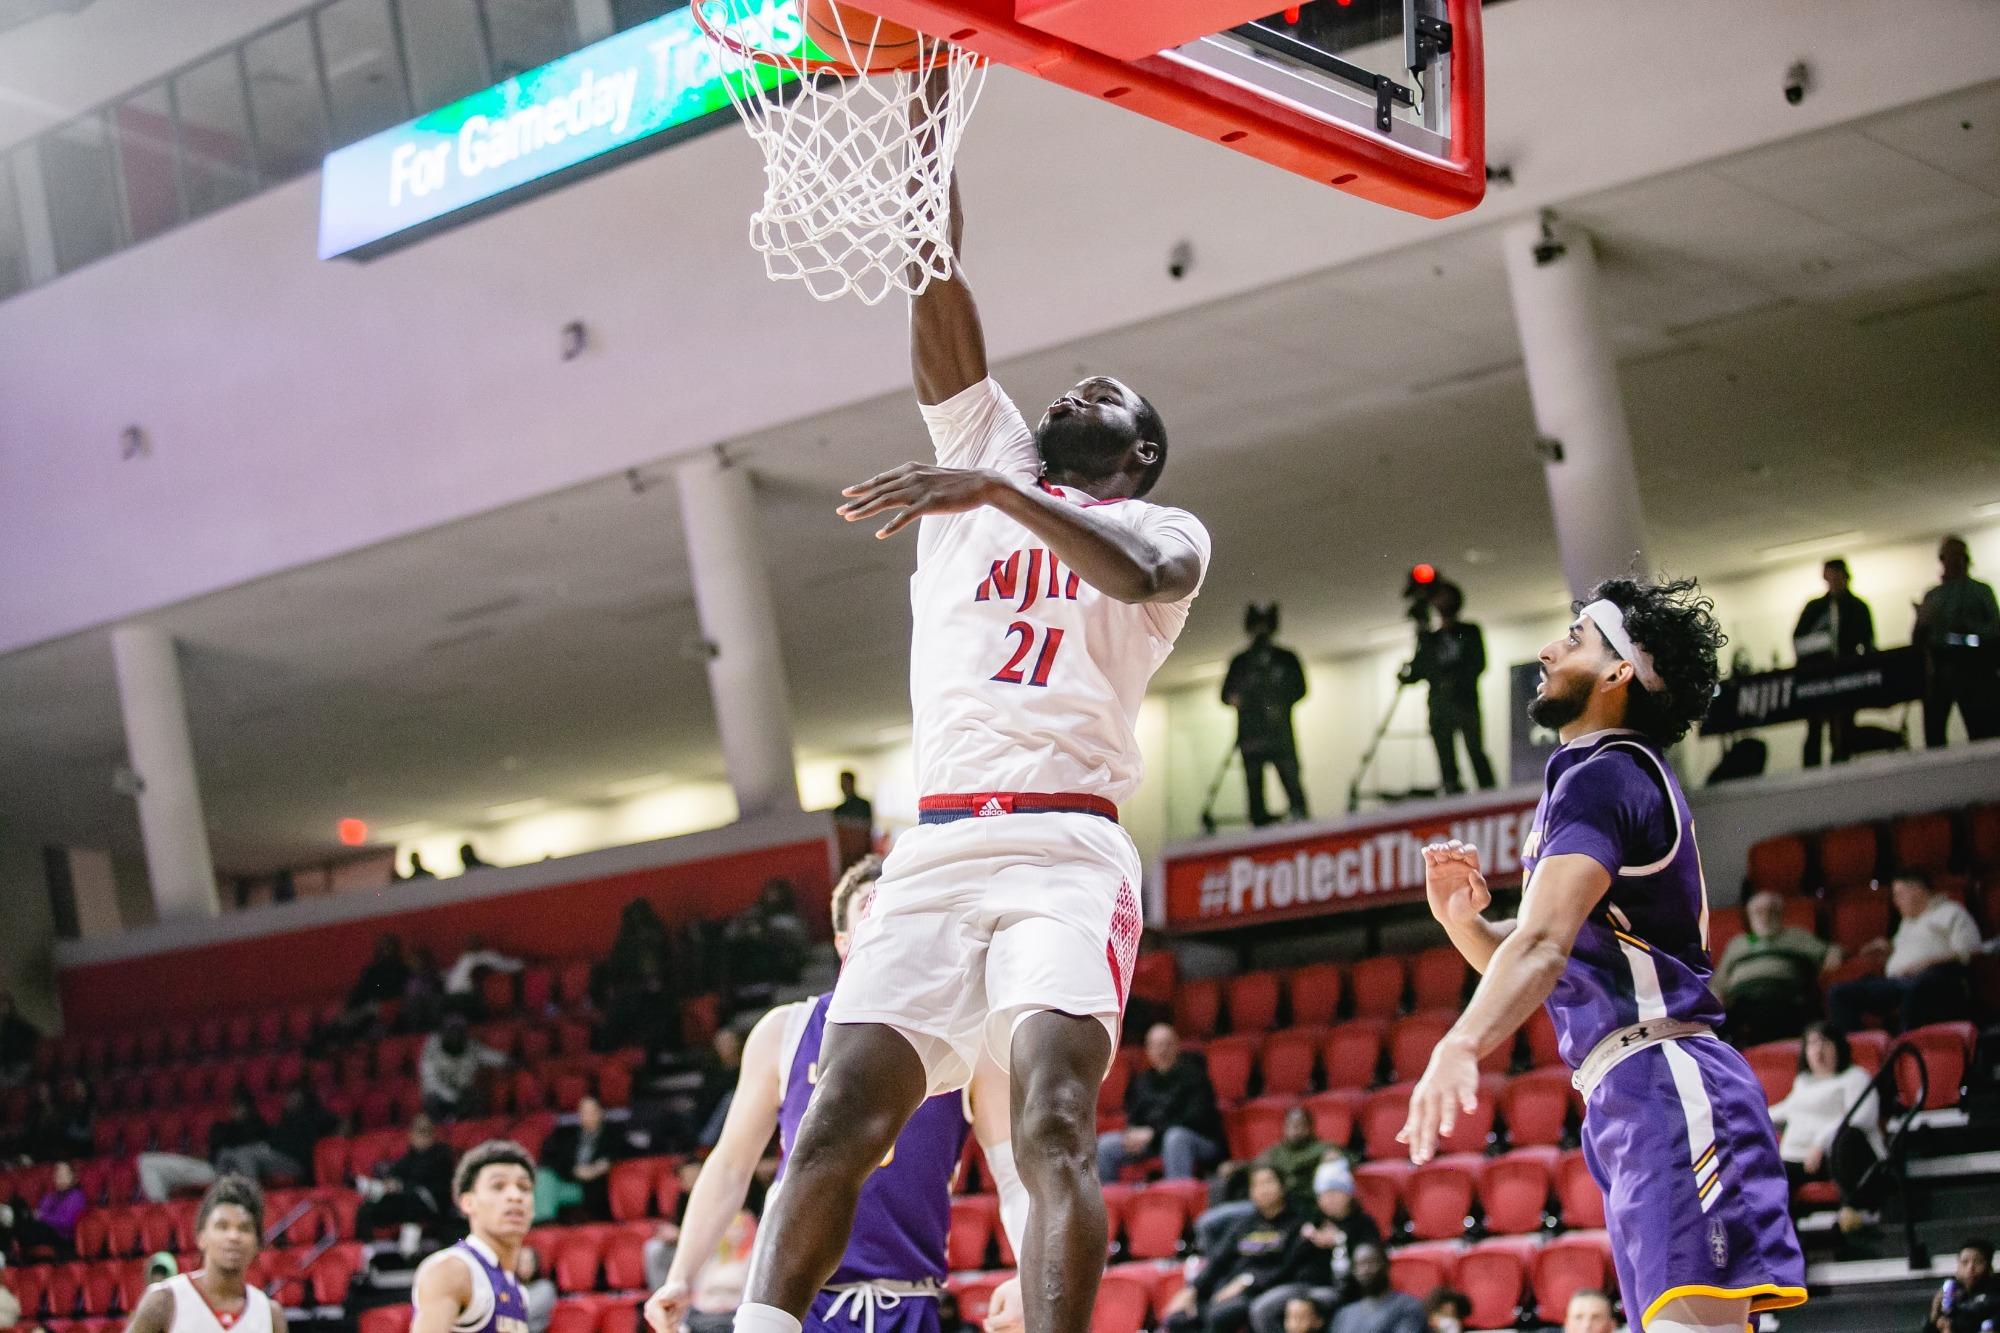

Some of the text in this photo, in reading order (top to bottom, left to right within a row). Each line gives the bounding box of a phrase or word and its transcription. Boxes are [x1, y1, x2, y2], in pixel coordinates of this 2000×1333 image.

[391, 141, 450, 206] For
[458, 67, 638, 177] Gameday
[989, 620, 1065, 688] 21
[979, 808, 1008, 816] adidas
